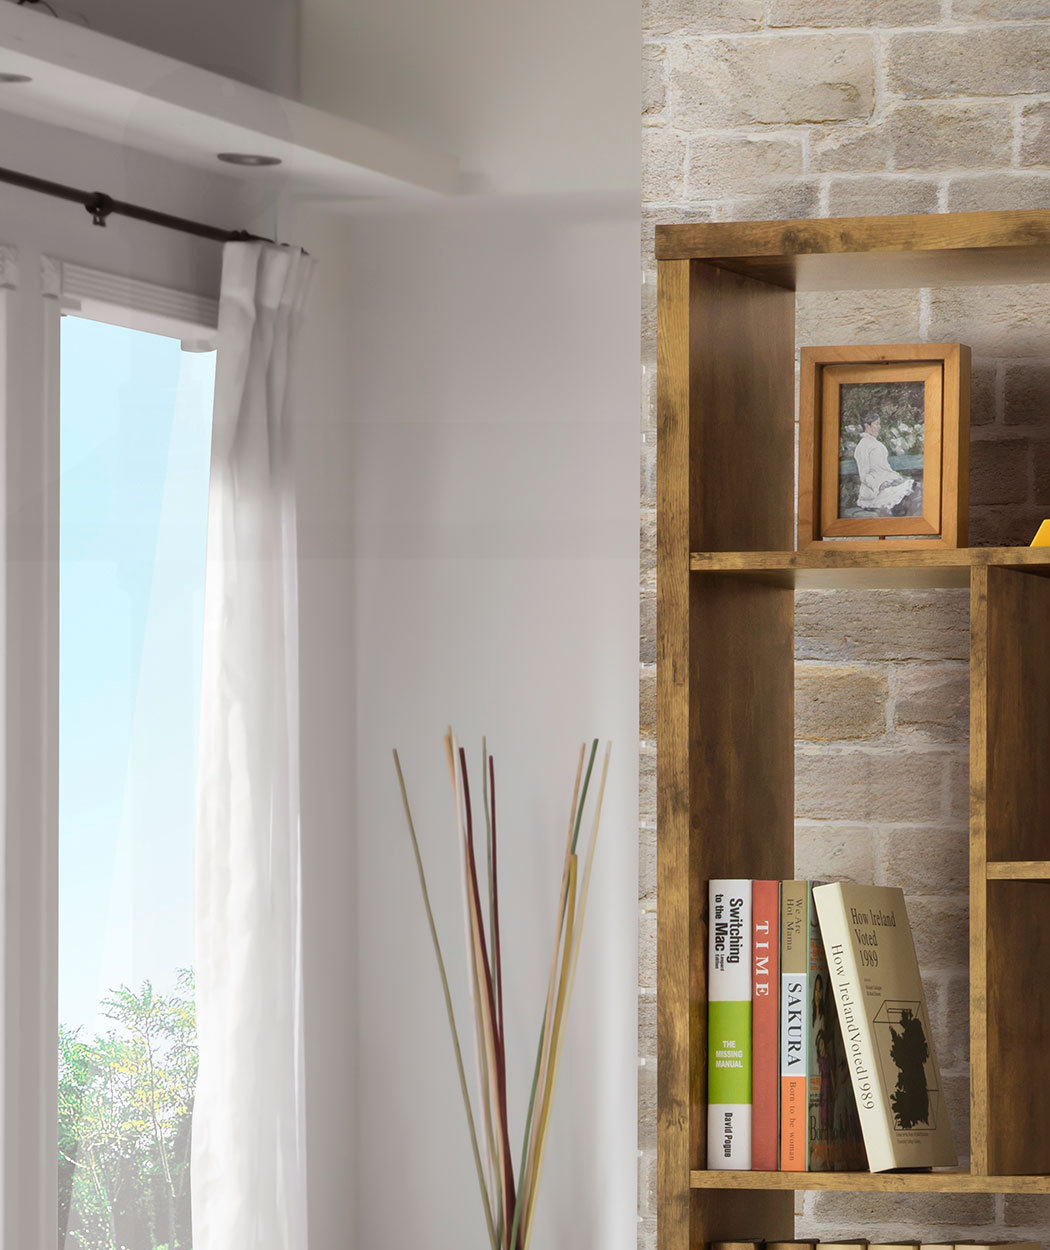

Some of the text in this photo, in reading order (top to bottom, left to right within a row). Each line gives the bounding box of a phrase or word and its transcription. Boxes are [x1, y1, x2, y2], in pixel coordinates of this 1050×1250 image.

[715, 894, 724, 903] to
[715, 904, 724, 919] the
[795, 898, 803, 935] We Are
[850, 907, 897, 928] How Ireland
[729, 898, 744, 964] Switching
[786, 898, 795, 951] Hot Mama
[714, 922, 728, 951] Mac
[854, 928, 878, 947] Voted
[755, 920, 769, 997] TIME
[831, 944, 846, 978] How
[859, 949, 879, 967] 1989
[787, 983, 802, 1067] SAKURA
[716, 1050, 743, 1058] MISSING
[723, 1040, 736, 1048] THE
[716, 1060, 743, 1068] MANUAL
[789, 1081, 797, 1102] Born
[789, 1104, 796, 1114] to
[789, 1118, 797, 1128] be
[723, 1112, 733, 1158] David Pogue
